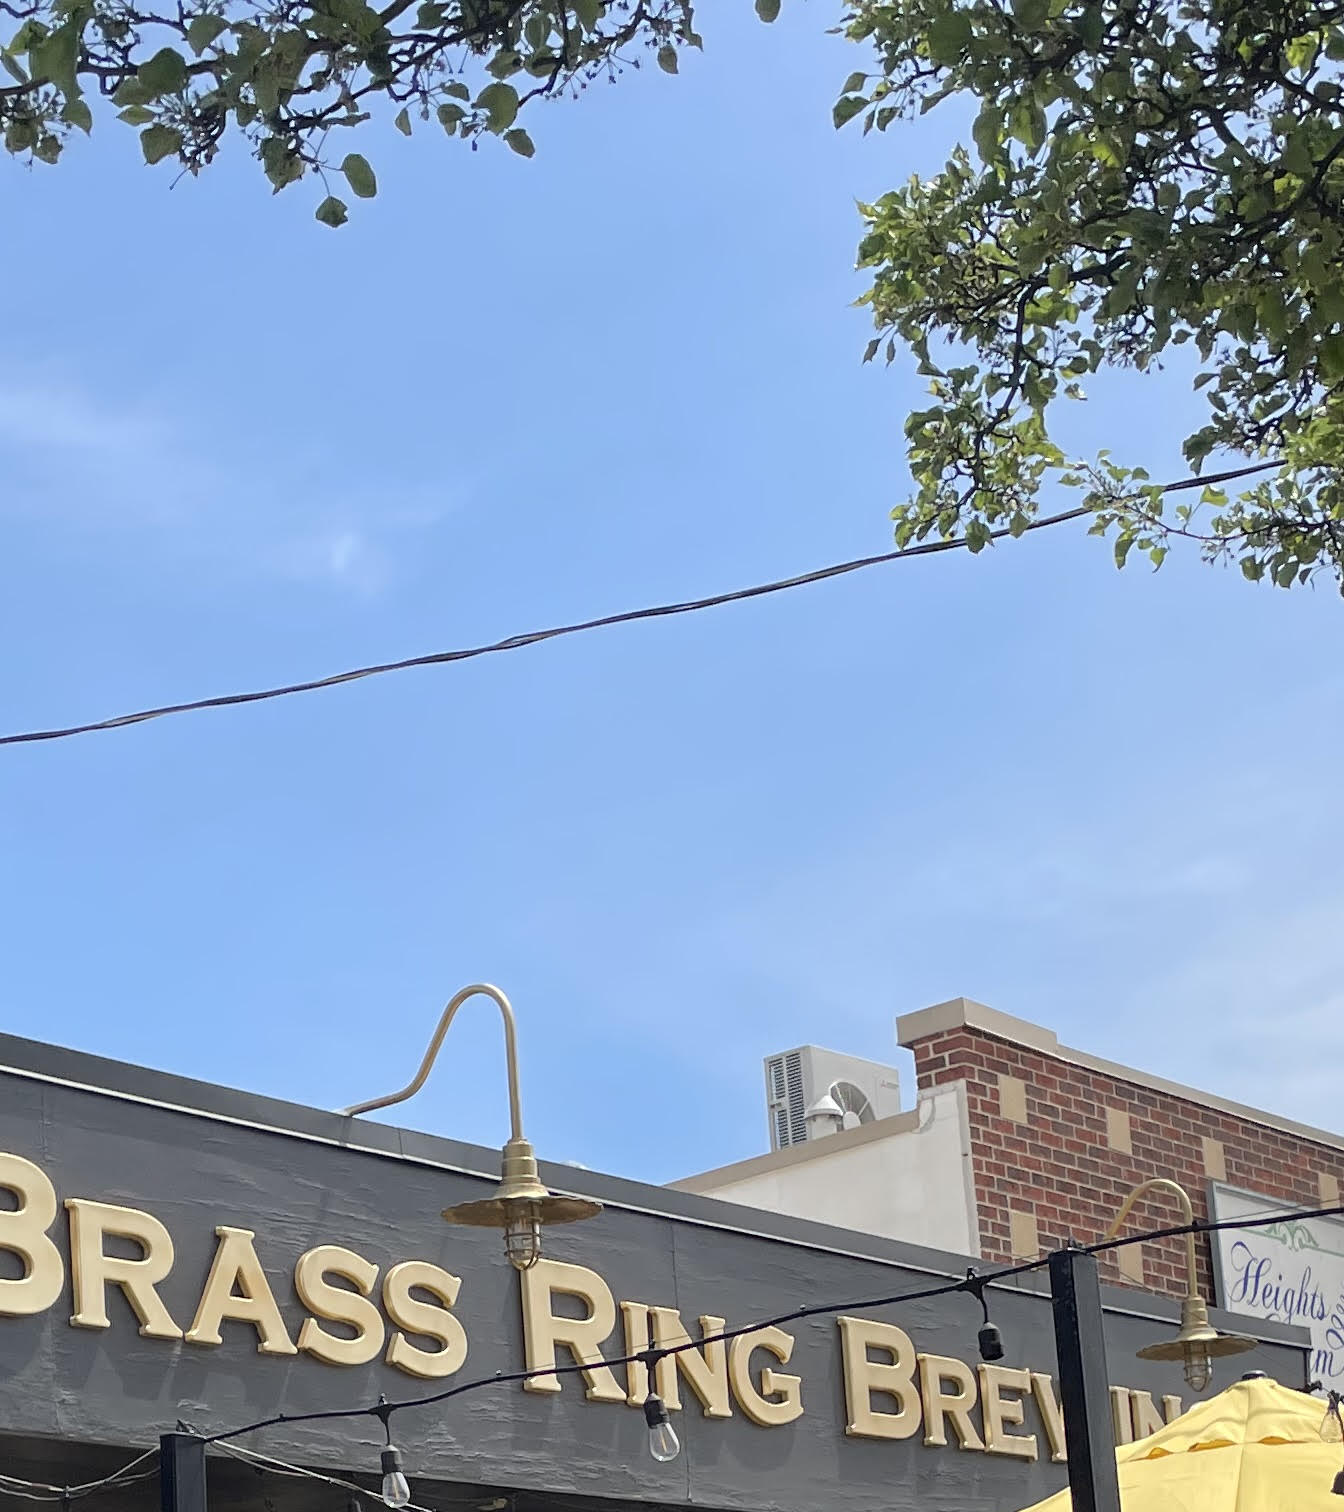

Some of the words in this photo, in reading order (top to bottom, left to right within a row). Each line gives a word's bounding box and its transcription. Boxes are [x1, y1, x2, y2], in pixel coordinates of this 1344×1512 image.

[1229, 1241, 1328, 1325] Heights
[520, 1257, 804, 1428] RING
[837, 1315, 1182, 1463] BREIN
